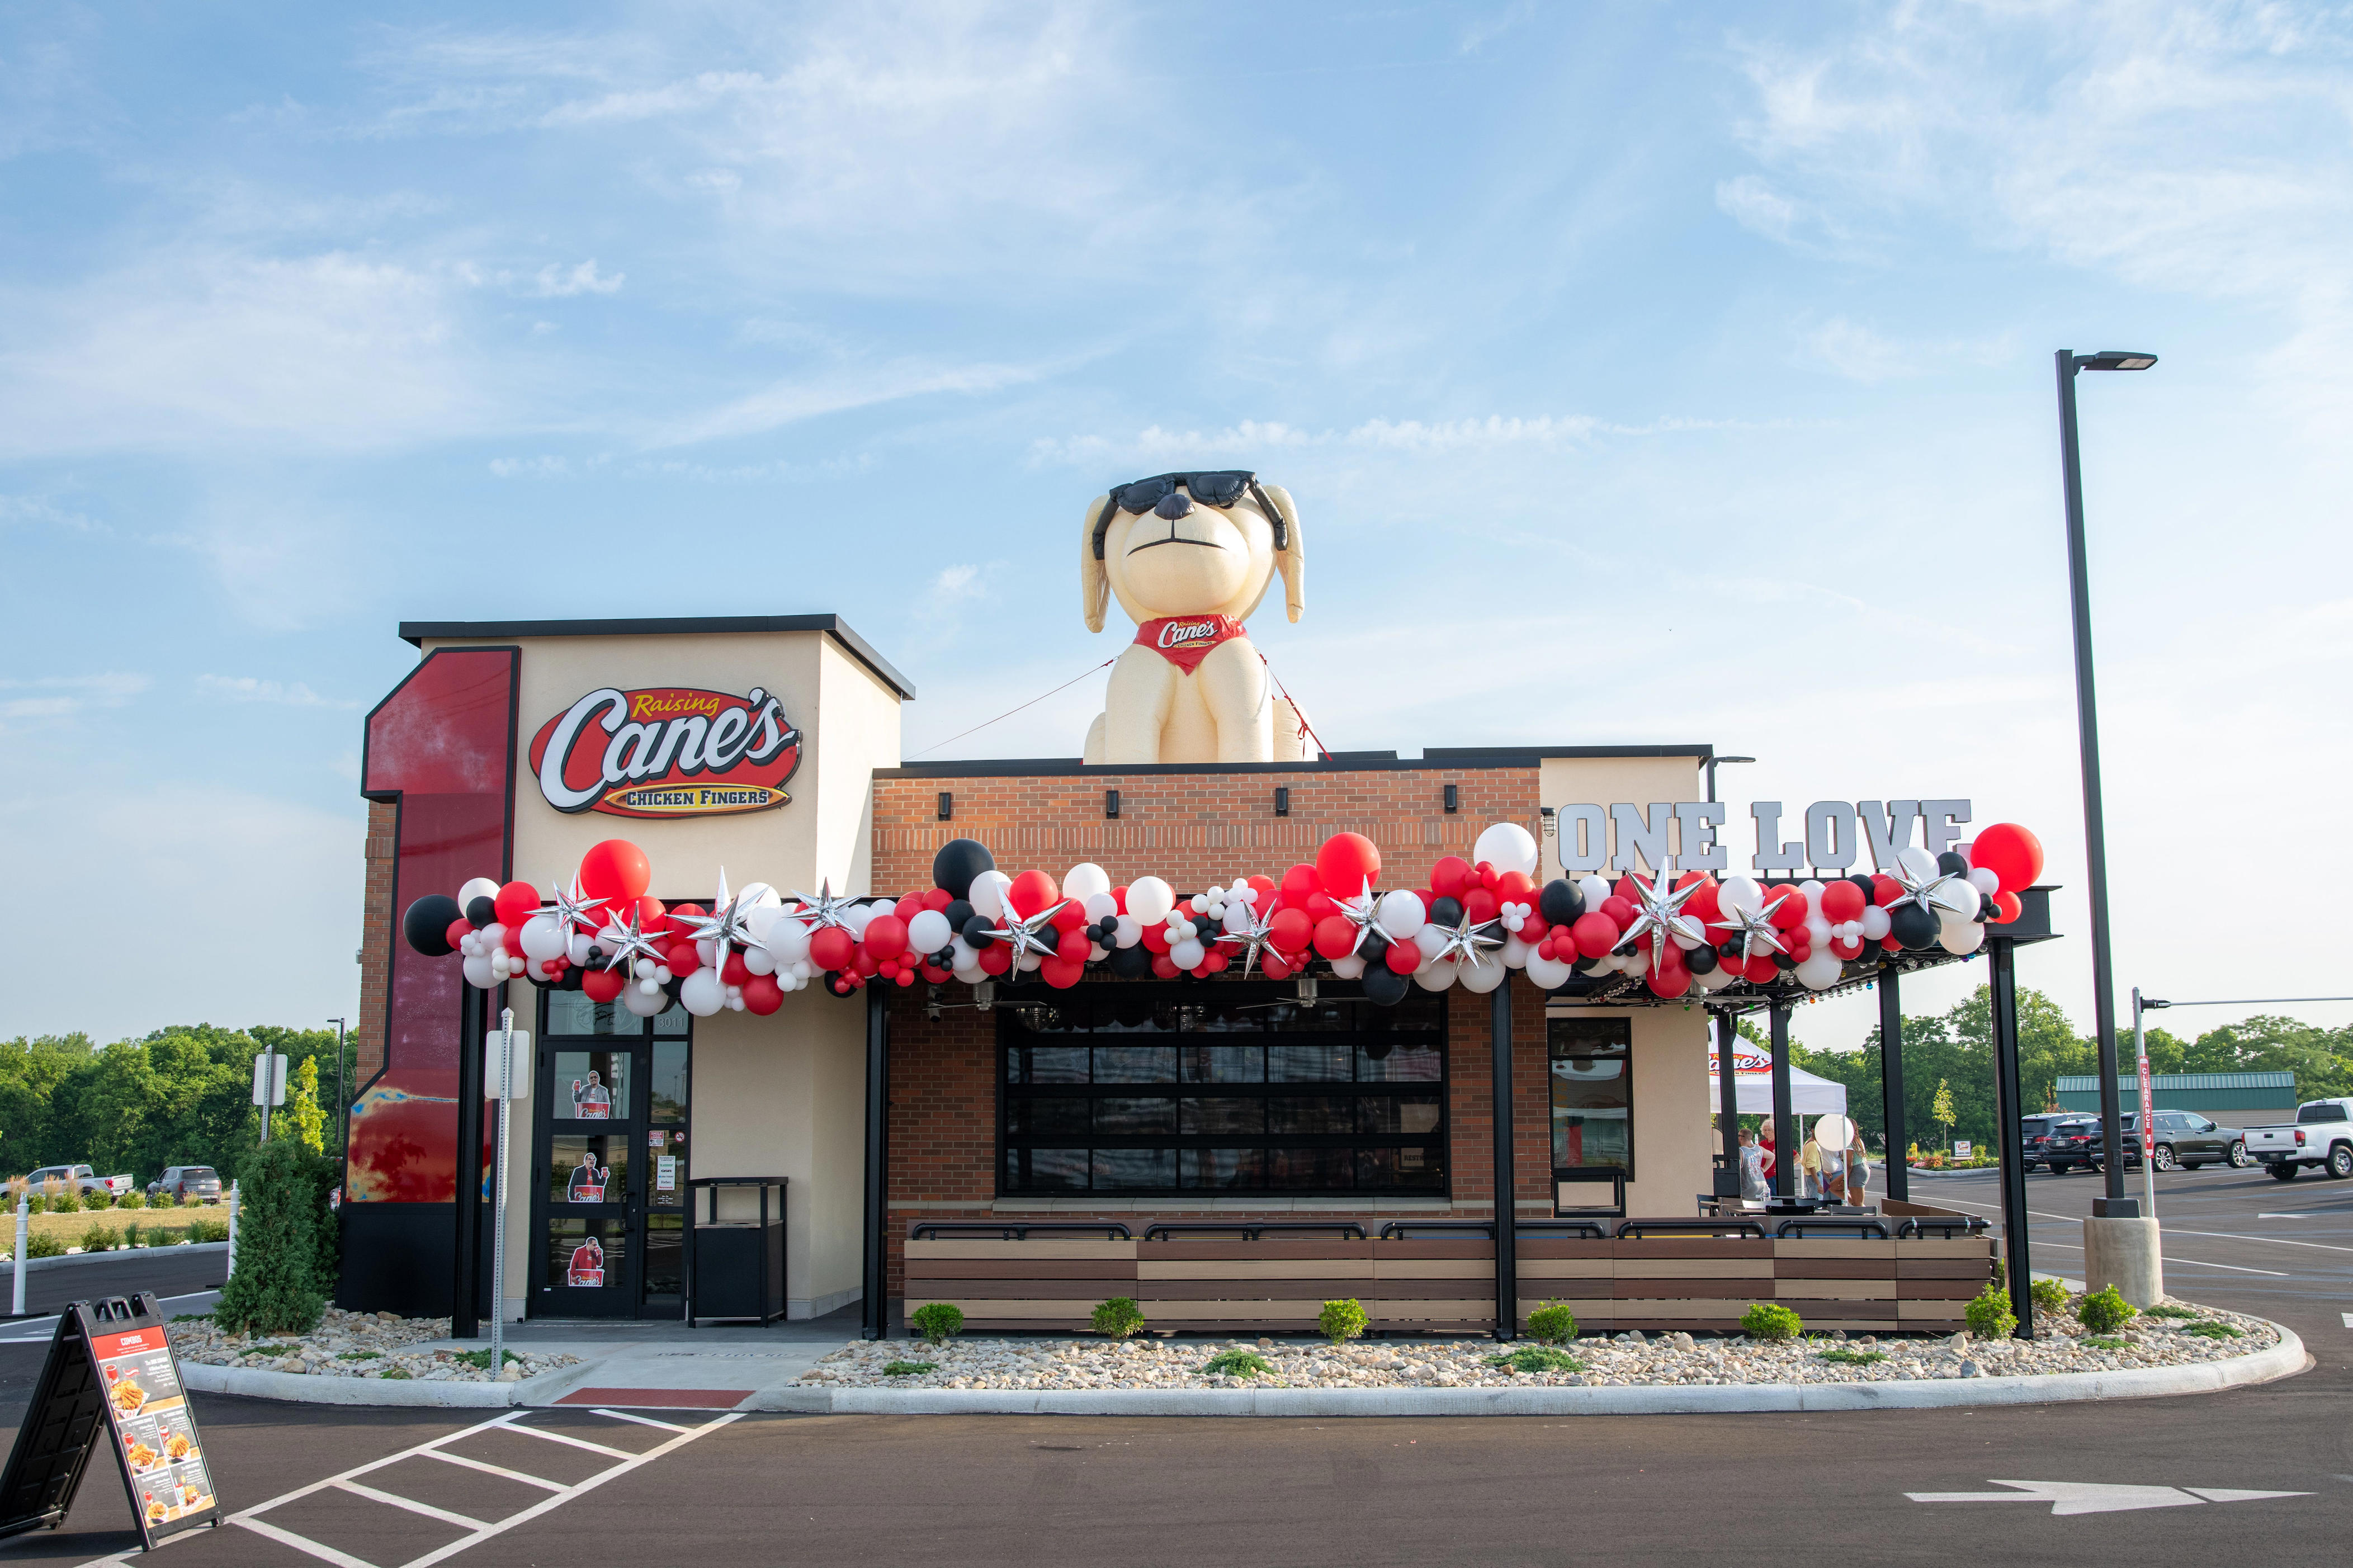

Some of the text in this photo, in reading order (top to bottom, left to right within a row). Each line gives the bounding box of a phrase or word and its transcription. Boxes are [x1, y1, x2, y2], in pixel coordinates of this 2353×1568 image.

[1157, 621, 1218, 649] Cane's
[632, 692, 721, 717] Raising
[539, 687, 797, 809] Cane's
[626, 789, 769, 807] CHICKEN FINGERS
[1558, 802, 1727, 871] ONE
[657, 1018, 684, 1027] 3011
[2142, 1068, 2151, 1128] CLEARANCE
[120, 1335, 143, 1345] COMBOS
